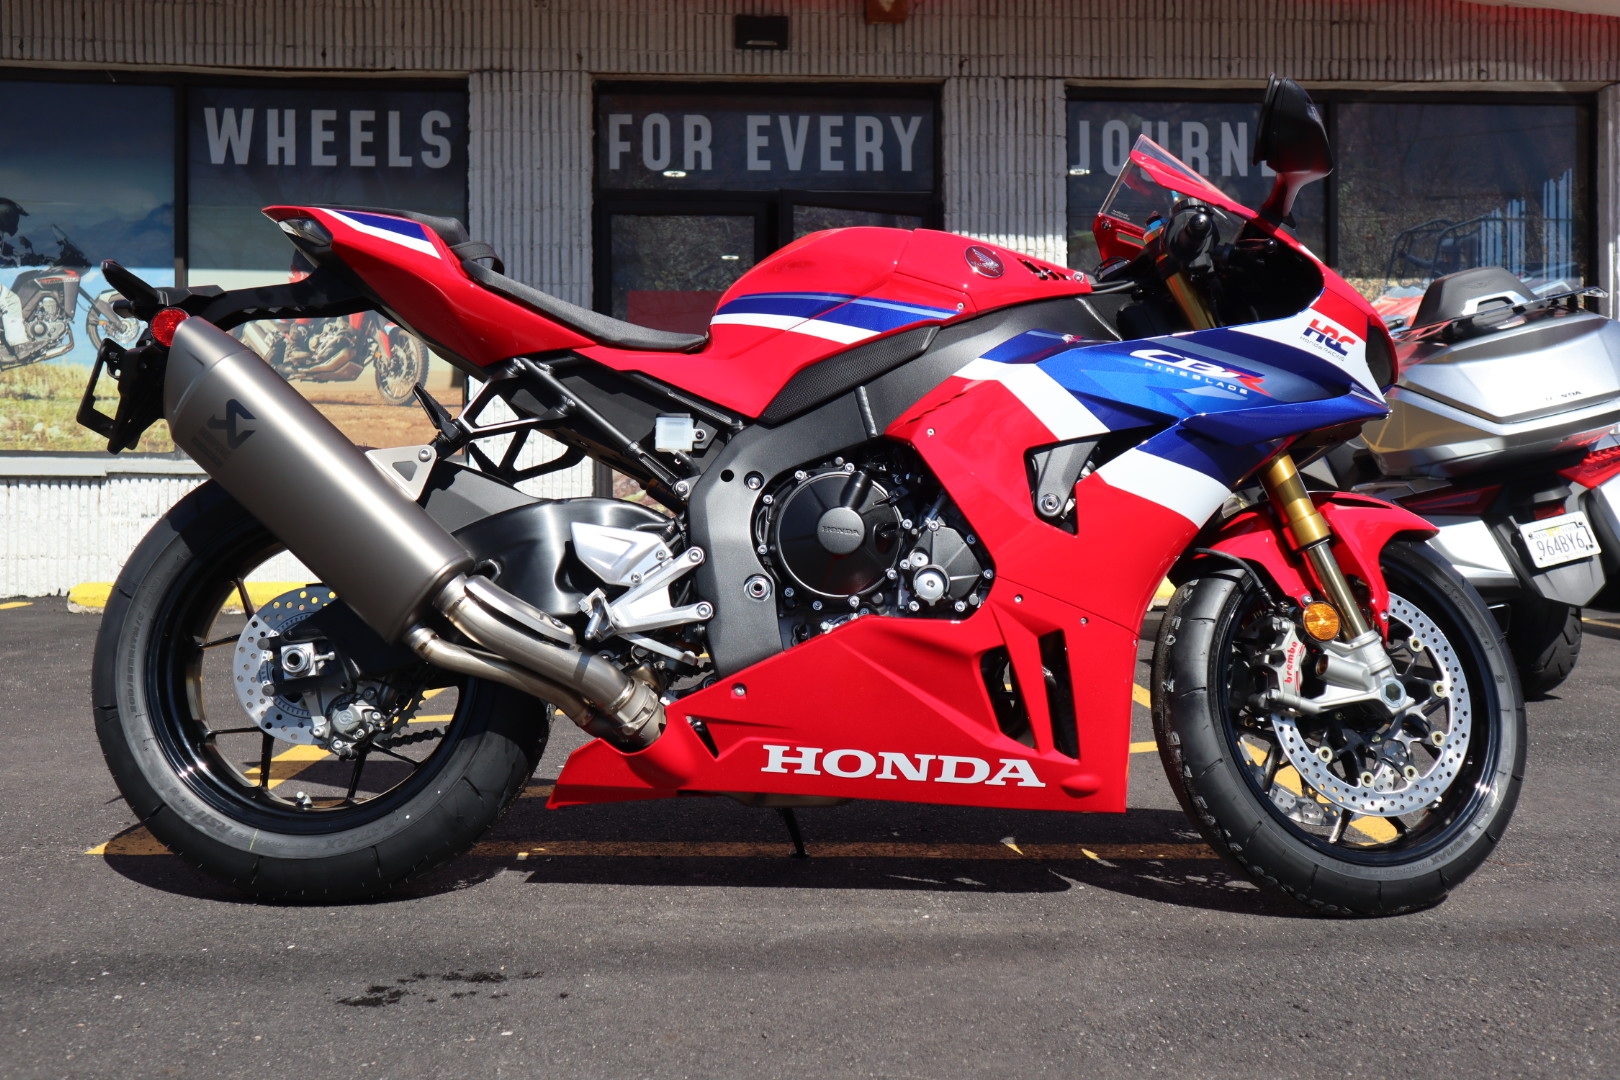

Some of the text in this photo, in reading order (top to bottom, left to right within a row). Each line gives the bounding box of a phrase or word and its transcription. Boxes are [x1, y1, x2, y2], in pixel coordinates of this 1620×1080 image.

[204, 107, 1277, 182] WHEELS FOR EVERY JOURN
[1303, 318, 1357, 357] HRC
[1129, 349, 1273, 397] CBR
[1144, 361, 1249, 395] FIREBLADE
[822, 525, 860, 537] HONDA
[1536, 532, 1586, 557] 964BY6
[1284, 641, 1298, 684] brembo
[760, 744, 1046, 788] HONDA
